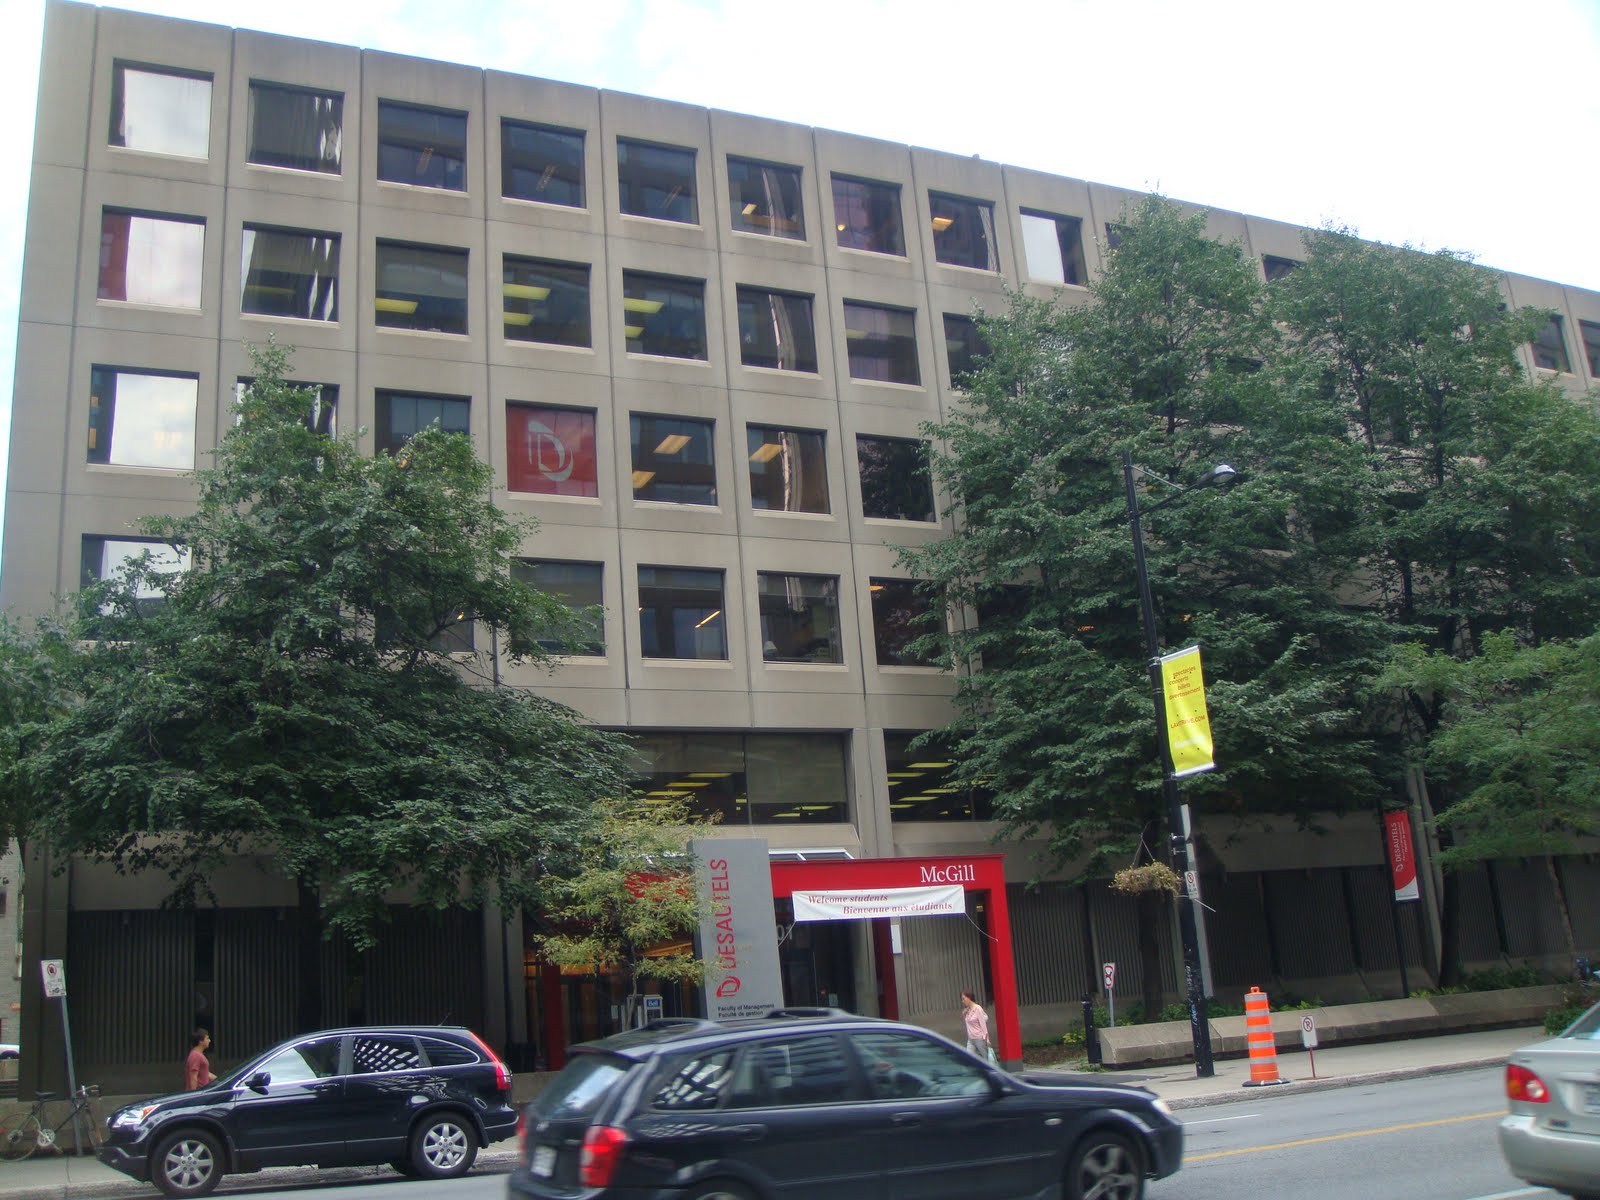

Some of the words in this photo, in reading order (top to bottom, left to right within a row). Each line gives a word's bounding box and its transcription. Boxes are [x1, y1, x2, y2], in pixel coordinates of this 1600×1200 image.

[1391, 822, 1402, 862] DESAUTELS
[920, 864, 975, 883] McGill
[808, 895, 848, 904] Welcome
[850, 894, 888, 902] students
[710, 859, 737, 969] DESAUTELS
[843, 905, 889, 915] Bienvenue
